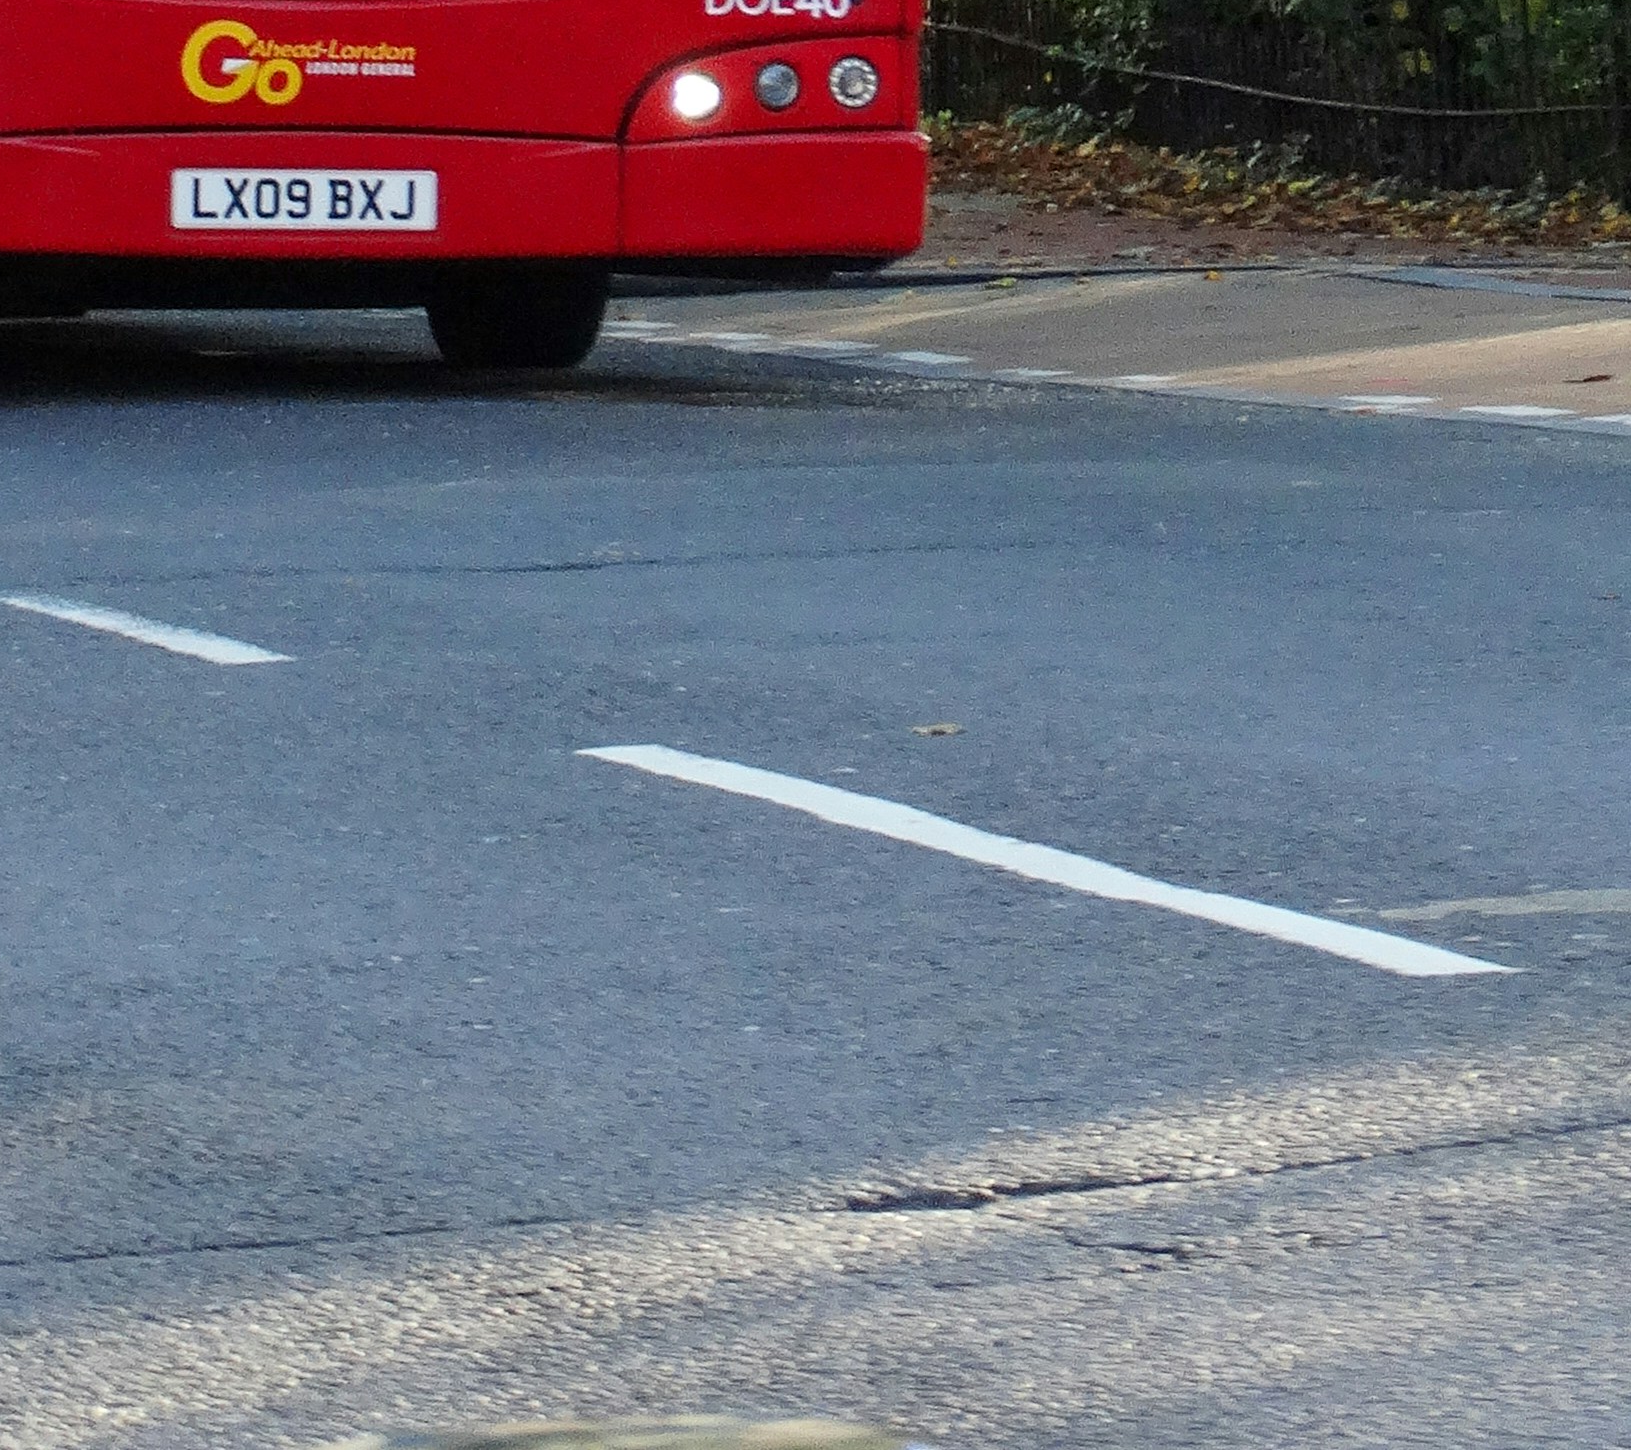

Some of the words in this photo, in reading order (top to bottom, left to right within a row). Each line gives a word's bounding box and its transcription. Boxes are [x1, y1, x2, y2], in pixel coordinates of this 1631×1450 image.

[180, 18, 304, 105] Go
[192, 177, 312, 220] LX09
[326, 178, 417, 221] BXJ
